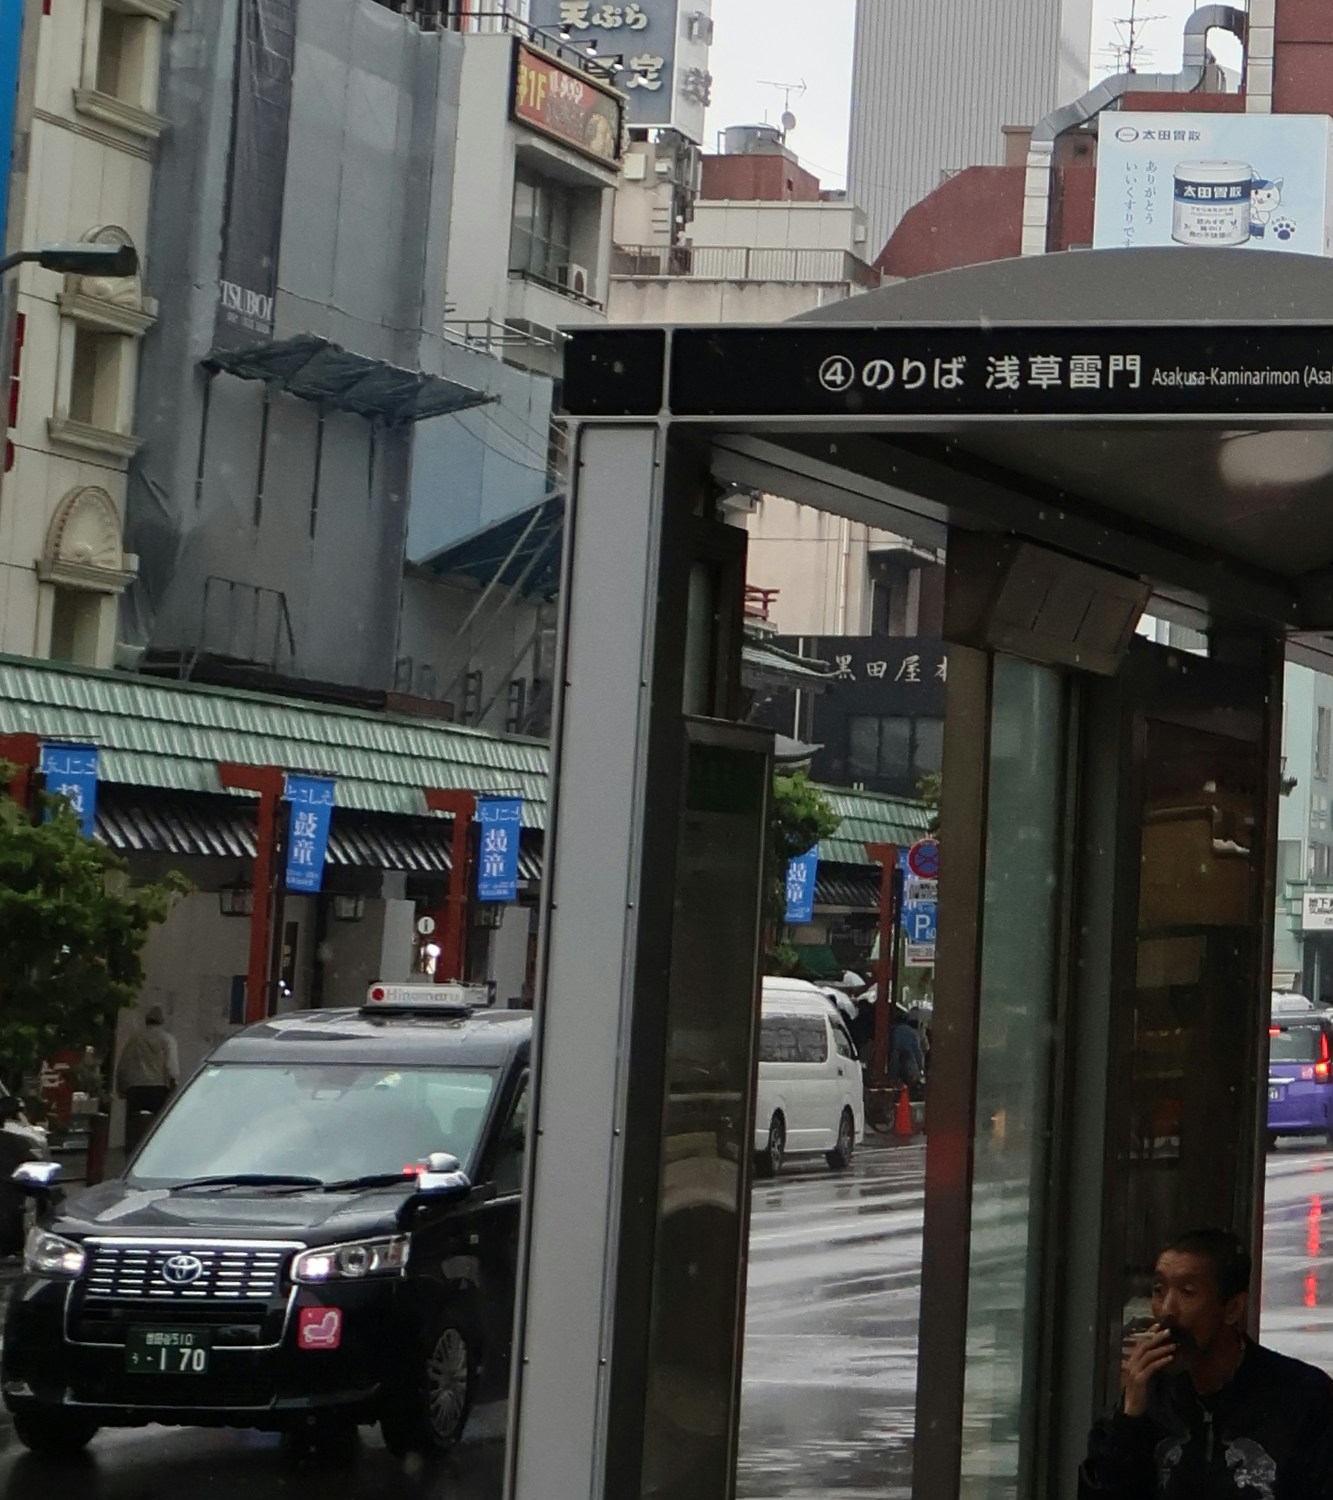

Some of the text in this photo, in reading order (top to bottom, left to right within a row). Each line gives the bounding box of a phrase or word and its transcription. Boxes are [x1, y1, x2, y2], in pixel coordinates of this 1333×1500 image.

[559, 0, 648, 30] 天ぷら
[1142, 129, 1201, 141] 太田胃散
[1146, 160, 1158, 224] ありがとう
[1183, 184, 1242, 199] 太田胃散
[984, 354, 1143, 391] 浅草雷門
[1151, 366, 1300, 388] Asakusa-Kaminarimon
